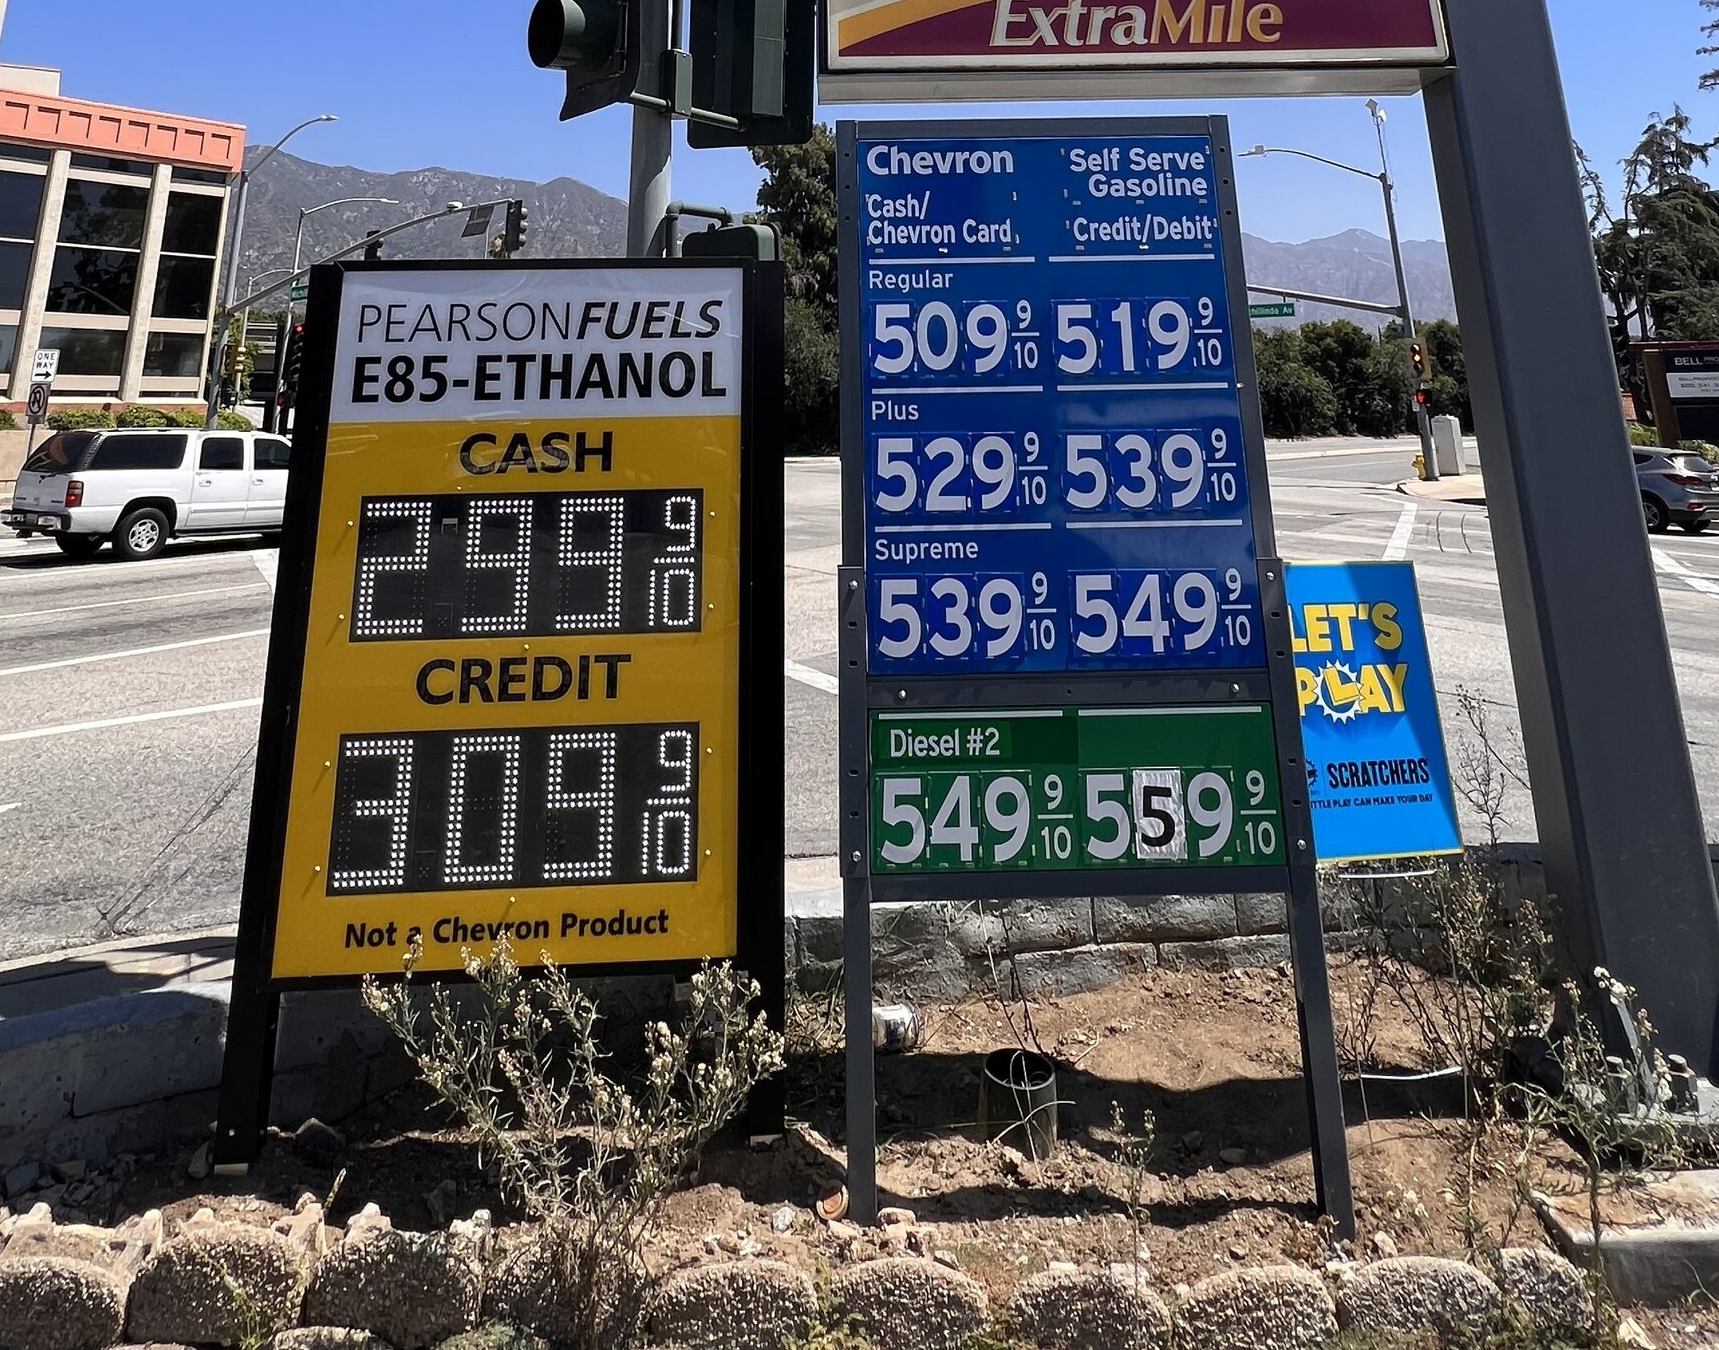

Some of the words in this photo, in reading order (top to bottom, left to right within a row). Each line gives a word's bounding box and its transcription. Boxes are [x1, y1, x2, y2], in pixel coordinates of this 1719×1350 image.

[867, 146, 1014, 175] Chevron
[1070, 148, 1120, 172] Self
[1129, 148, 1205, 171] Serve
[1088, 174, 1207, 198] Gasoline
[868, 191, 930, 219] Cash/
[869, 221, 955, 245] Chevron
[963, 219, 1011, 243] Card
[1073, 215, 1212, 243] Credit/Debit
[869, 270, 953, 293] Regular
[874, 301, 1008, 374] 509
[1057, 301, 1191, 374] 519
[36, 361, 54, 369] WAY
[37, 352, 55, 361] ONE
[1674, 357, 1702, 365] BELL
[352, 351, 727, 404] E85-ETHANOL
[871, 400, 918, 421] Plus
[459, 431, 613, 475] CASH
[1066, 433, 1204, 509] 539
[876, 436, 1015, 512] 529
[356, 497, 625, 635] 299
[875, 539, 979, 564] Supreme
[879, 578, 1023, 658] 539
[1075, 572, 1217, 653] 549
[416, 653, 632, 705] CREDIT
[1295, 663, 1408, 716] PLAY
[890, 729, 960, 758] Diesel
[966, 727, 1000, 757] #2
[1327, 757, 1430, 789] SCRATCHERS
[333, 731, 617, 888] 309
[1085, 772, 1234, 859] 559
[1311, 799, 1331, 809] ITTLE
[1333, 798, 1351, 808] PLAY
[1354, 797, 1372, 807] CAN
[1373, 796, 1395, 805] MAKE
[1396, 795, 1418, 804] YOUR
[1419, 793, 1433, 803] DAY
[881, 776, 1030, 863] 549
[345, 922, 396, 949] Not
[406, 926, 422, 946] a
[433, 915, 550, 944] Chevron
[561, 908, 669, 938] Product
